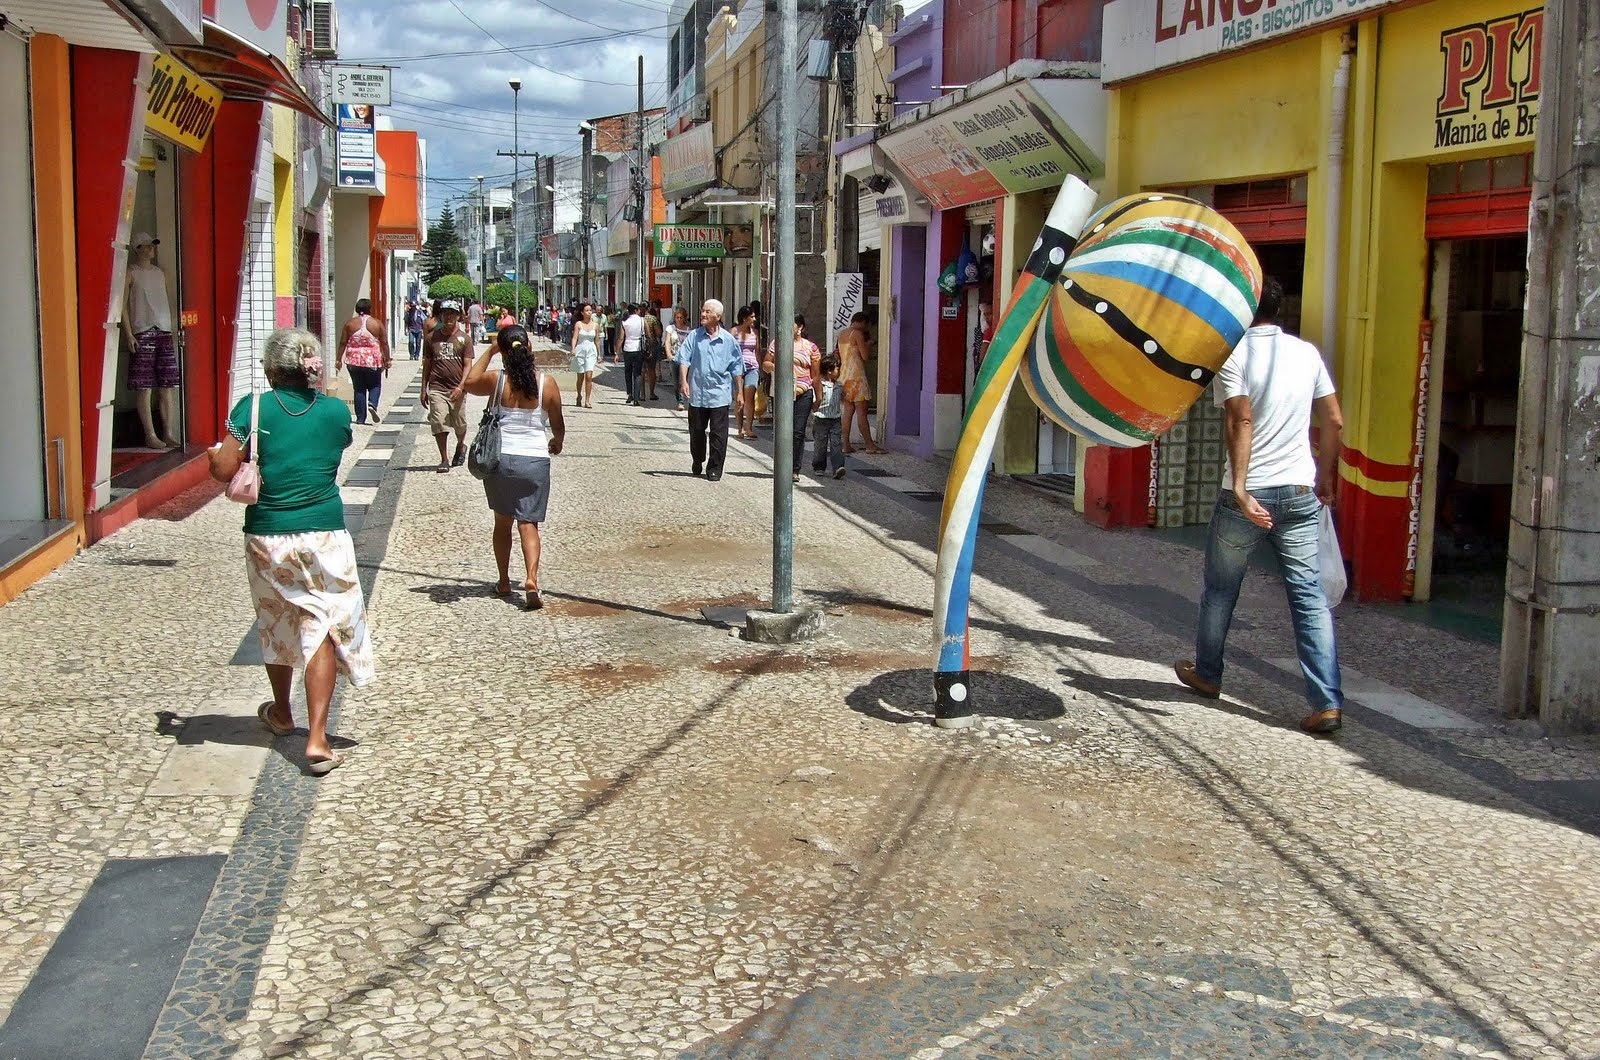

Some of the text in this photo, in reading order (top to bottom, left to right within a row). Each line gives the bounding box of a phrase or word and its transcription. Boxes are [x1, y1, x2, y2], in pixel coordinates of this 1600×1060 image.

[1155, 0, 1277, 43] LAN
[1262, 0, 1333, 34] BISCOITOS
[162, 74, 215, 140] Próprio
[953, 99, 1027, 137] Casa Gonçalo &
[1434, 105, 1539, 148] Mania de Br
[976, 131, 1052, 163] Gonçalo Modas
[1020, 165, 1043, 178] 3621
[659, 227, 724, 242] DENTISTA
[1148, 437, 1159, 507] LVORADA
[1406, 472, 1423, 571] ALVORADA
